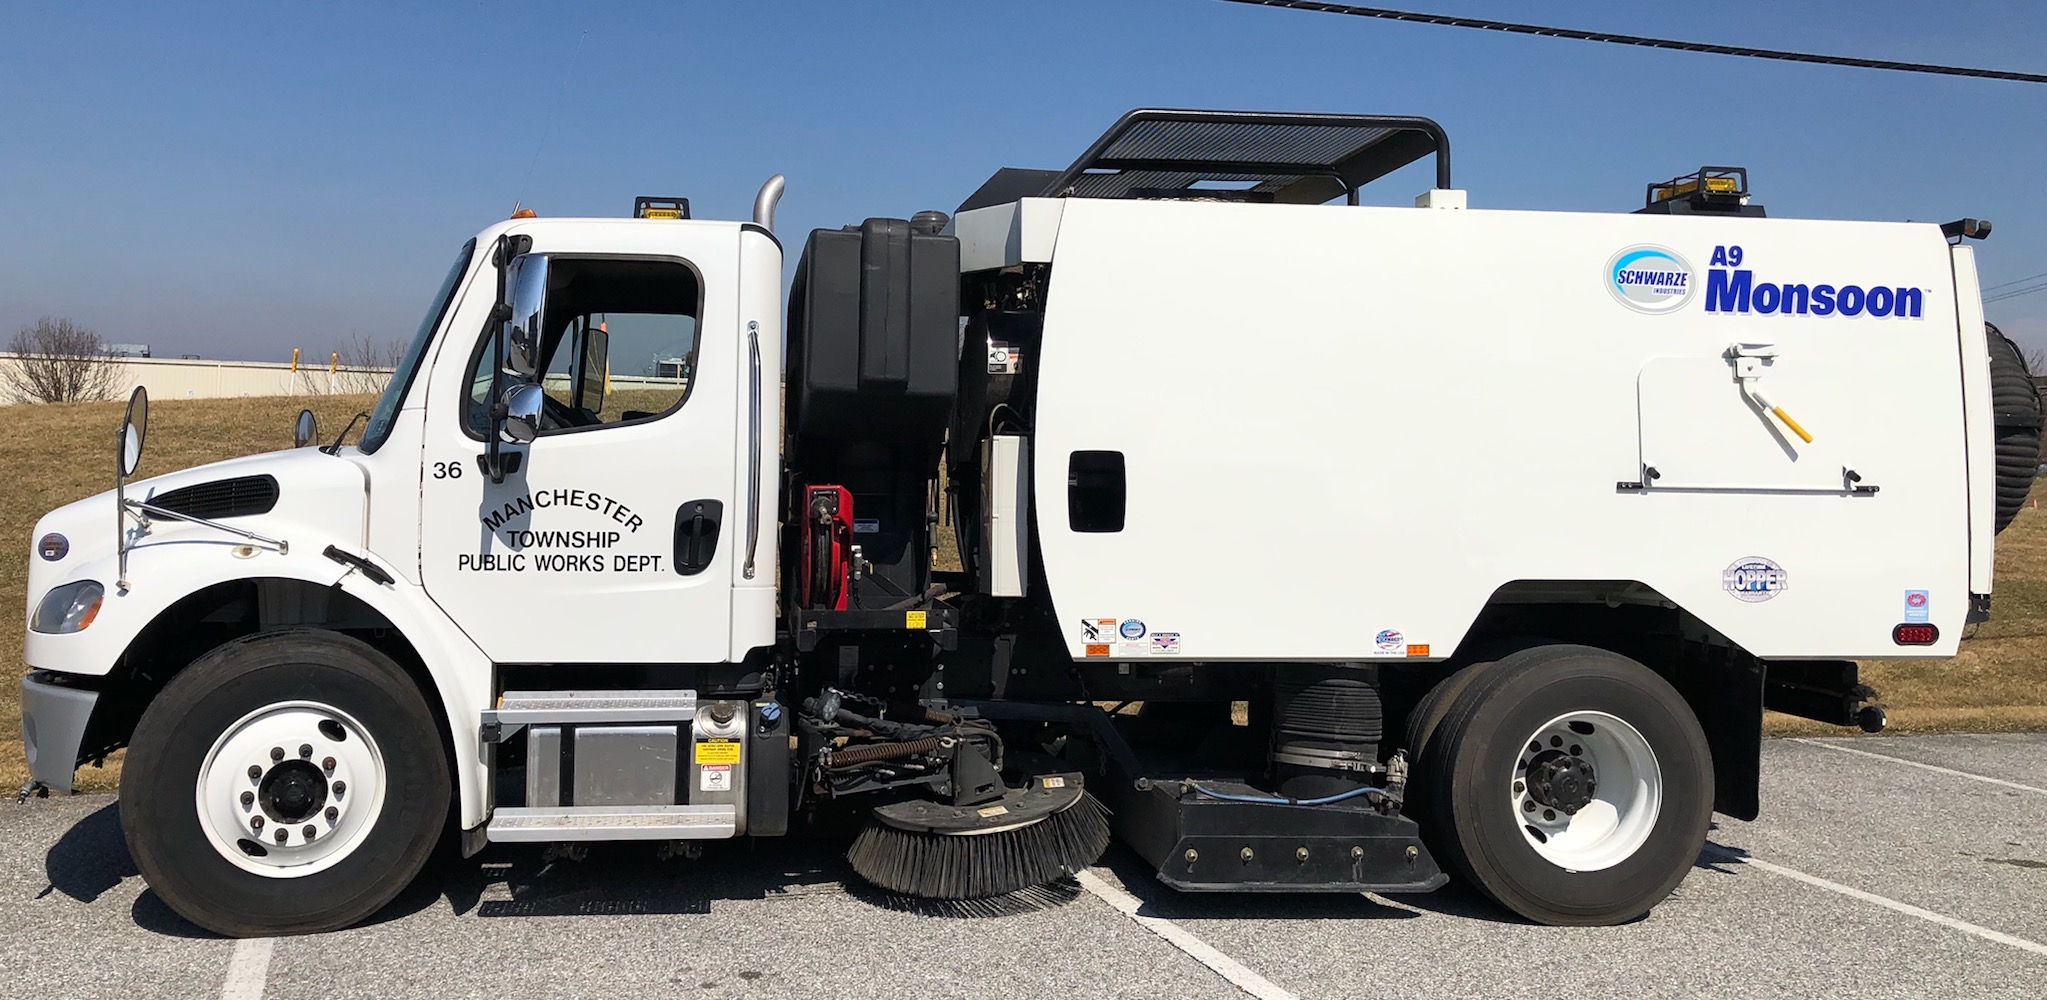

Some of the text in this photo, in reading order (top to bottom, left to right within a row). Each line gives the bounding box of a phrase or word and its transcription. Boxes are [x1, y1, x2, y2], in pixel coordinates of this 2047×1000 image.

[1709, 245, 1743, 267] A9
[1617, 269, 1688, 287] SCHWARZE
[1653, 287, 1686, 296] INDUSTRIES
[1704, 268, 1923, 318] Monsoon
[433, 461, 462, 479] 36
[482, 489, 643, 533] MANCHESTER
[506, 530, 620, 549] TOWNSHIP
[458, 554, 665, 572] PUBLIC WORKS DEPT.
[1722, 569, 1789, 591] HOPPER
